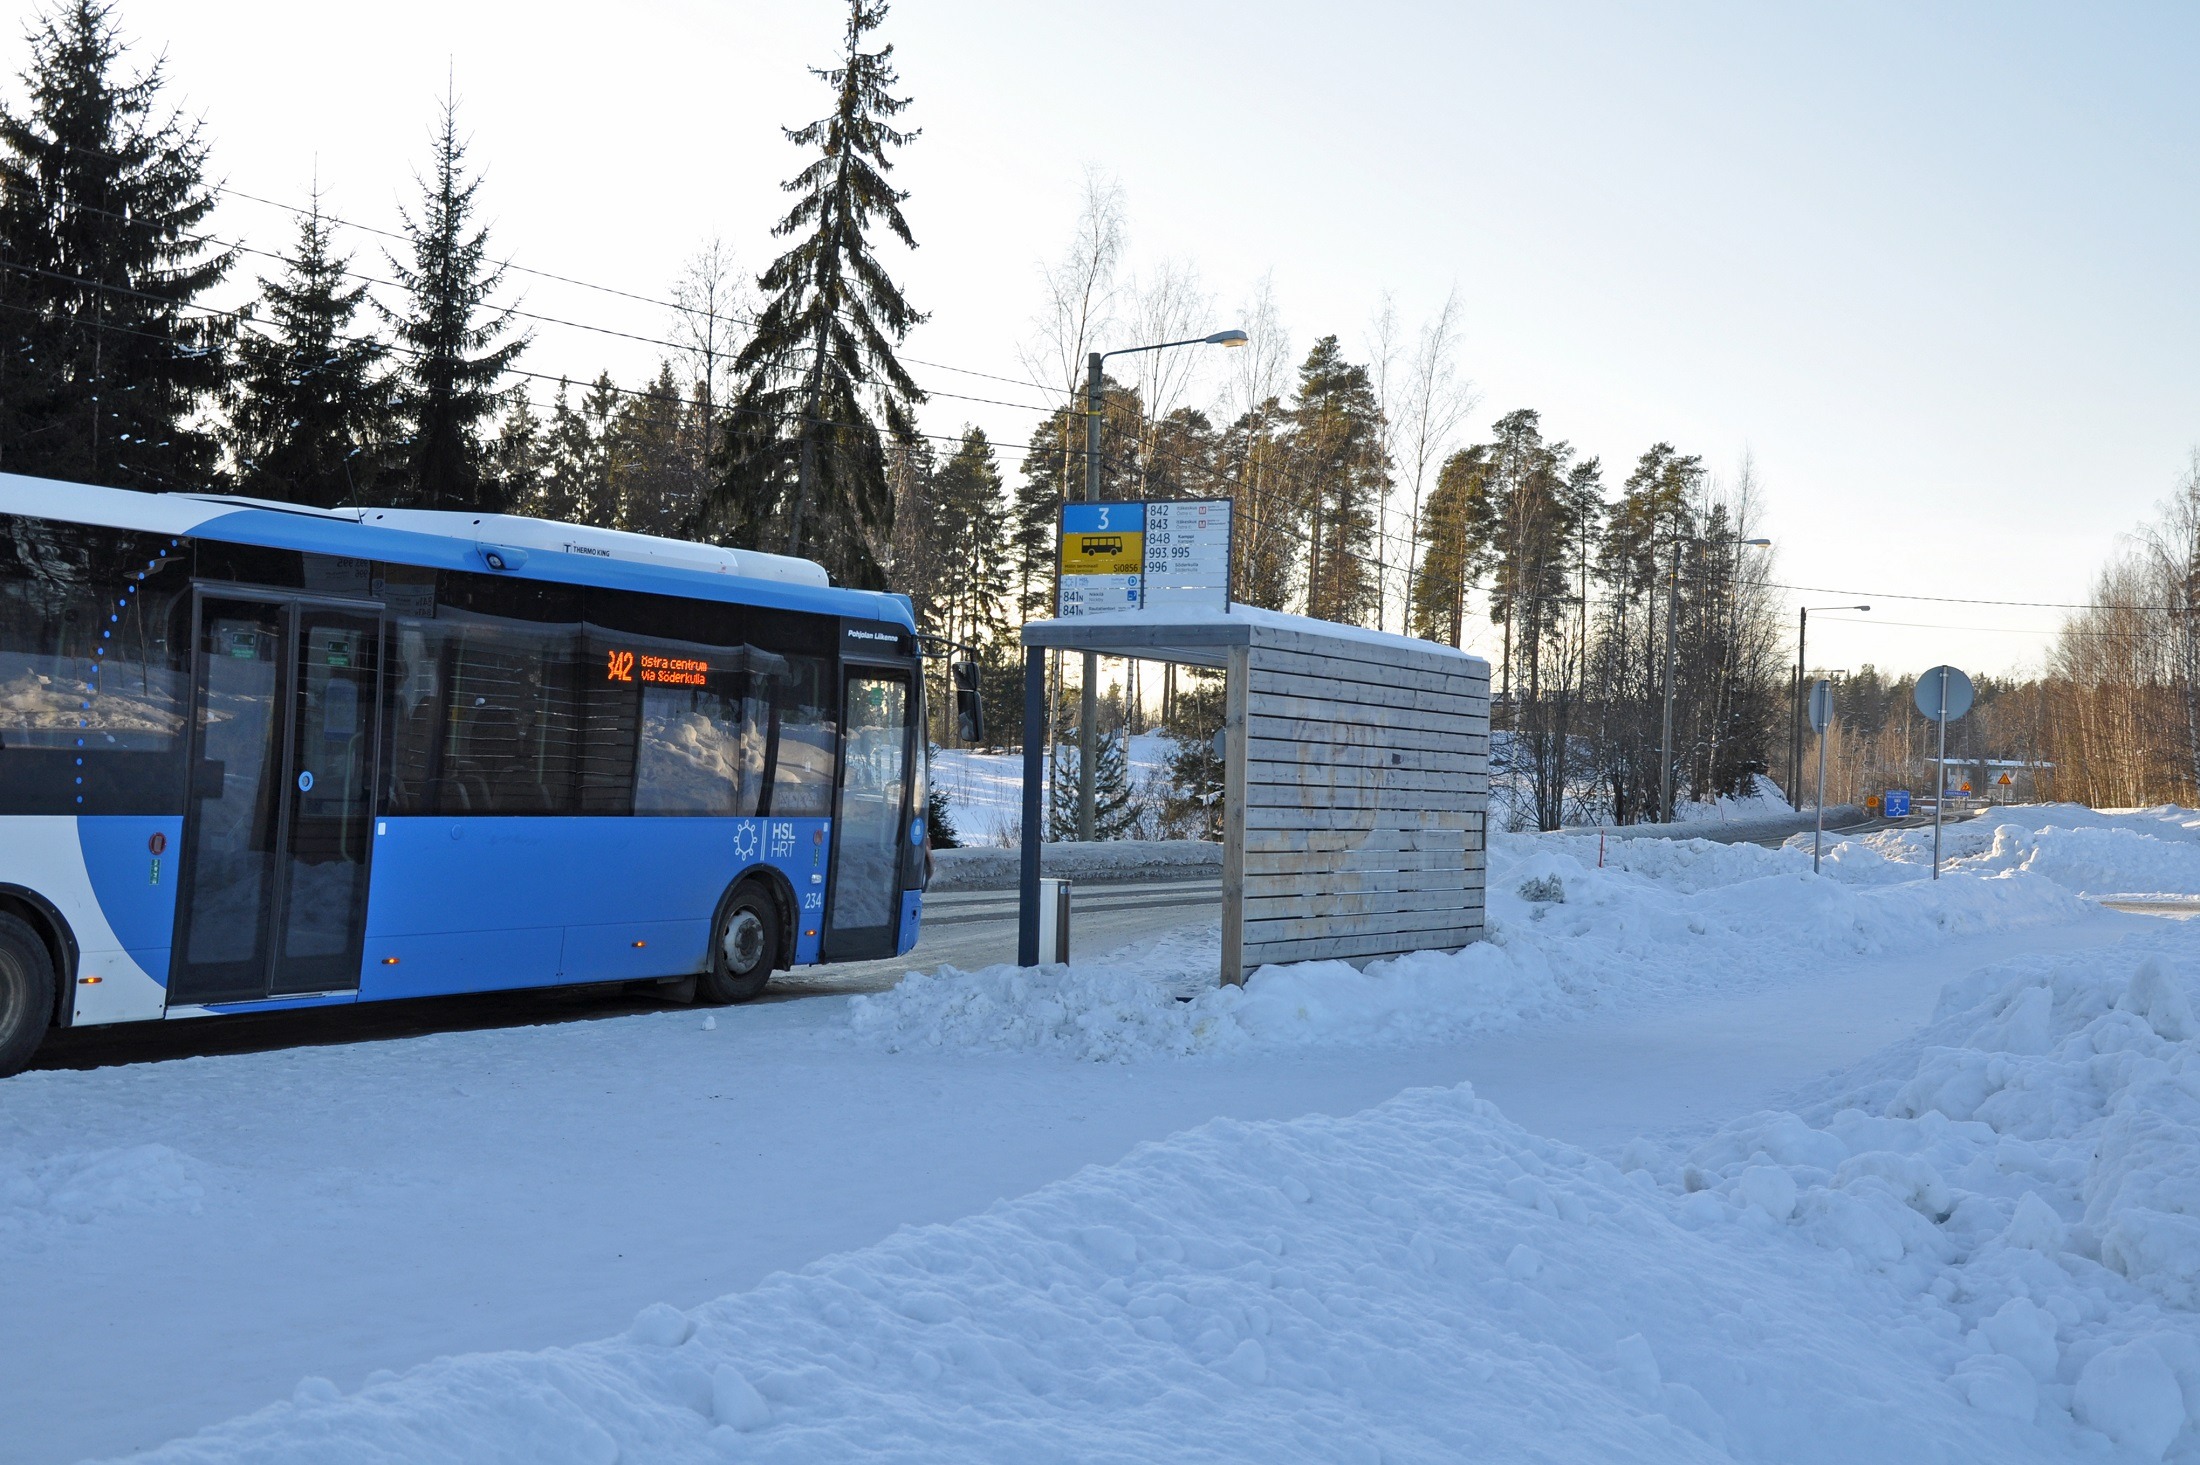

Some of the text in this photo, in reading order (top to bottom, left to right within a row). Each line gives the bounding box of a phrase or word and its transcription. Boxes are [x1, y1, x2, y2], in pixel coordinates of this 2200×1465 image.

[1150, 505, 1169, 516] 842
[1097, 507, 1110, 530] 3
[1150, 519, 1168, 530] 843
[1149, 533, 1171, 545] 848
[573, 545, 597, 556] THERMO
[597, 548, 610, 557] KING
[1171, 547, 1190, 558] 995
[1113, 564, 1138, 573] Si0856
[1148, 561, 1167, 572] 996
[848, 629, 899, 642] Pohjolan Liikenne
[670, 658, 708, 672] centrum
[657, 670, 706, 685] Söderkulla
[772, 822, 796, 840] HSL
[771, 841, 795, 857] HRT
[805, 893, 822, 909] 234
